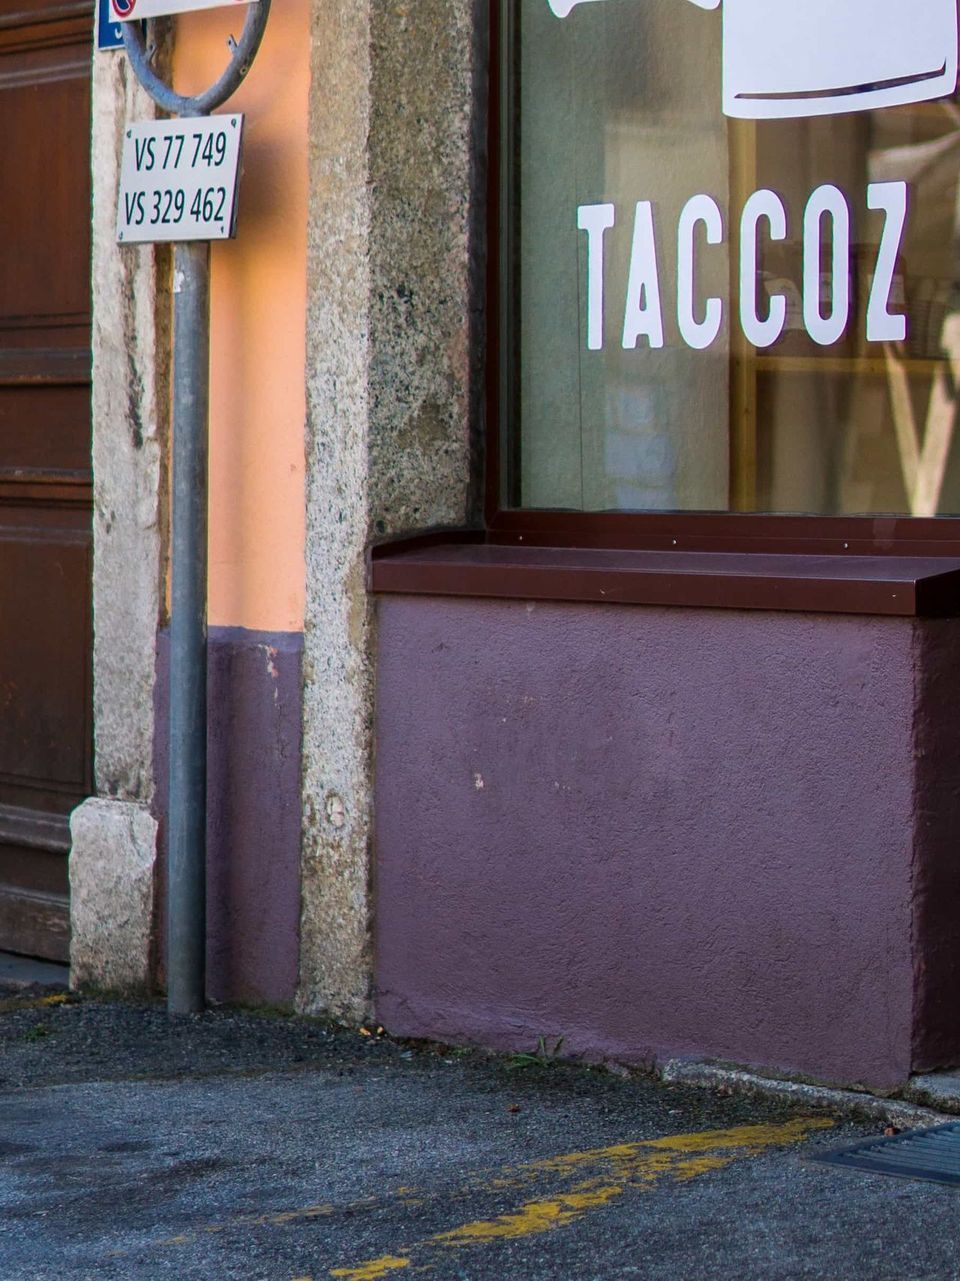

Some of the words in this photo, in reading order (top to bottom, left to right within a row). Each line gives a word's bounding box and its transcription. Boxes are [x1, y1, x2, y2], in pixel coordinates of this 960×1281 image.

[135, 136, 156, 172] VS
[162, 134, 185, 170] 77
[191, 131, 227, 167] 749
[125, 190, 146, 226] VS
[150, 188, 185, 224] 329
[190, 186, 226, 222] 462
[577, 181, 907, 350] TACCOZ
